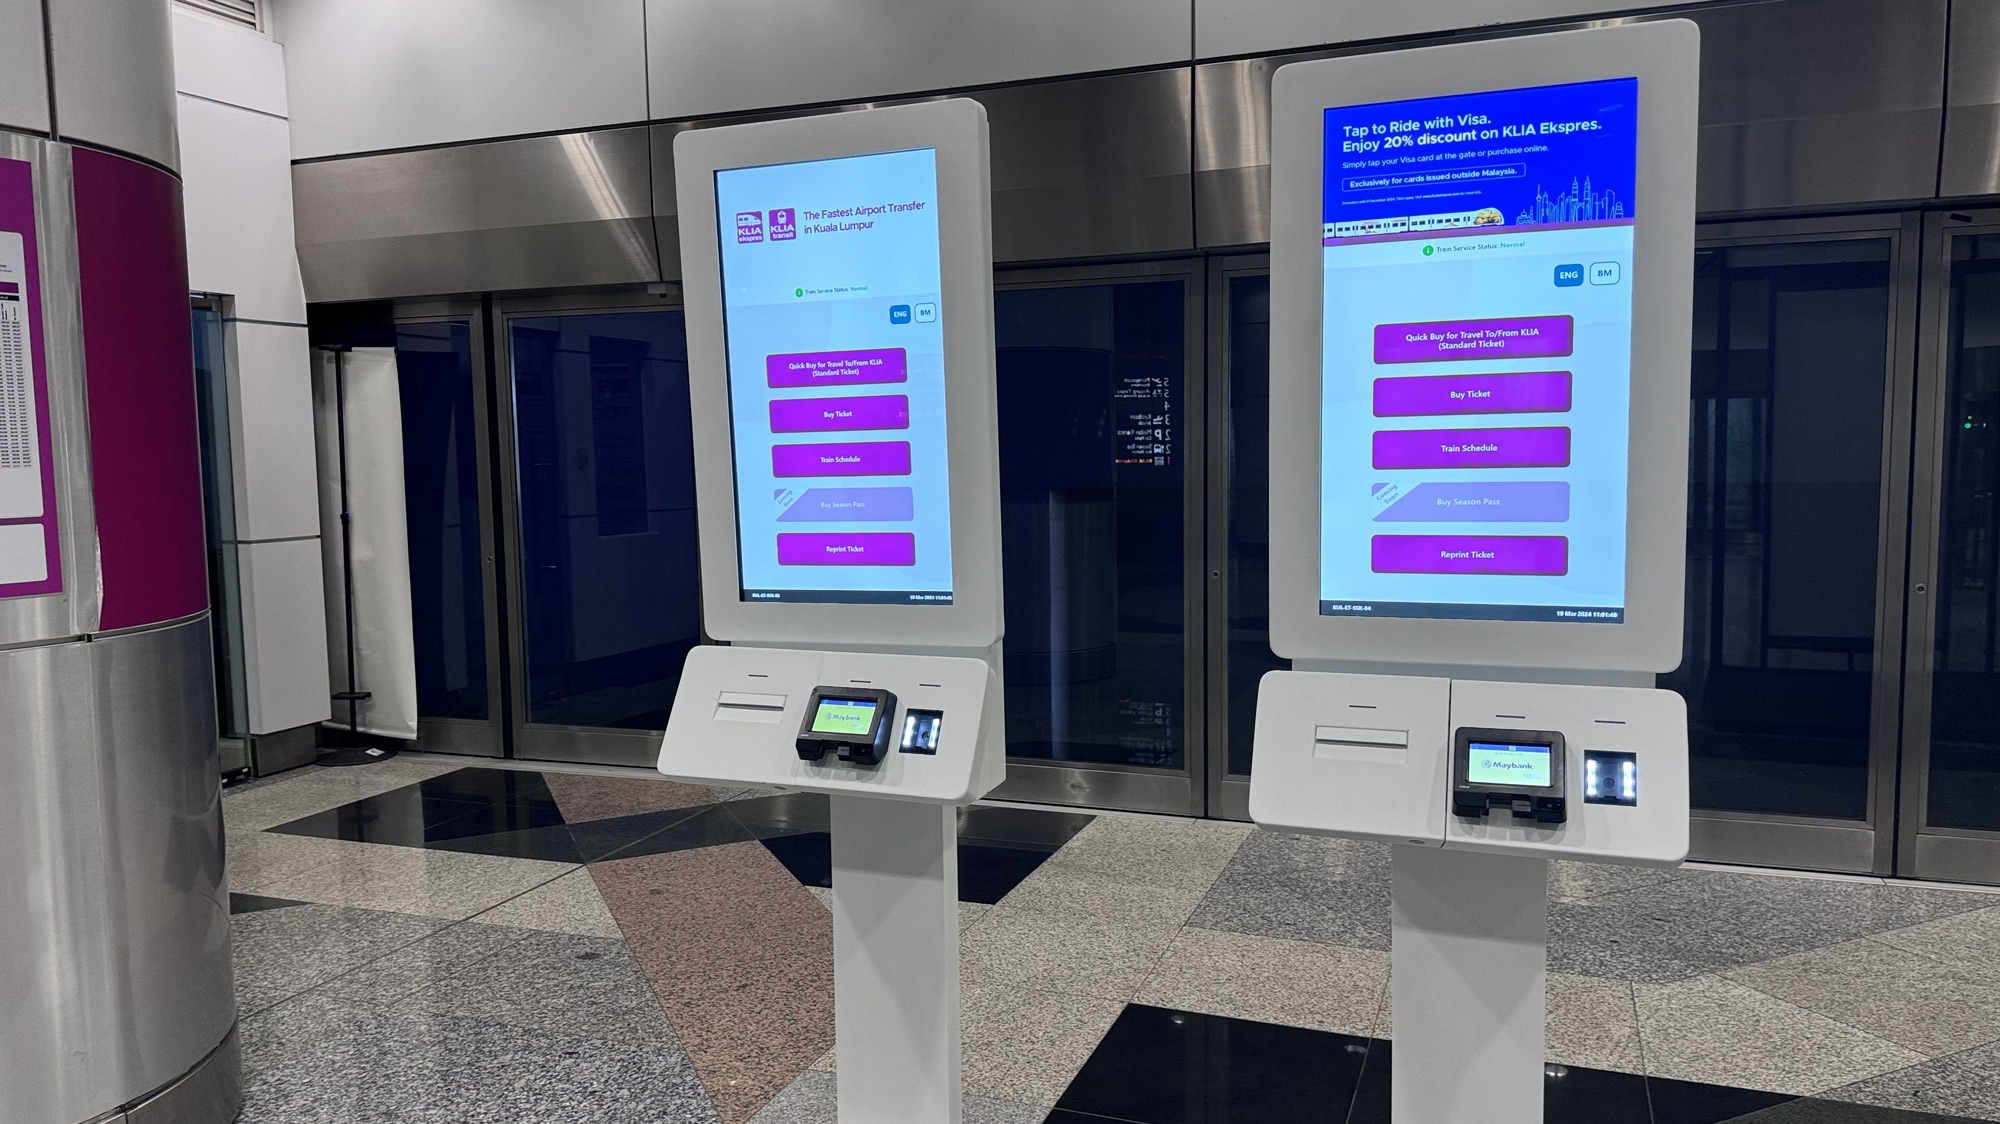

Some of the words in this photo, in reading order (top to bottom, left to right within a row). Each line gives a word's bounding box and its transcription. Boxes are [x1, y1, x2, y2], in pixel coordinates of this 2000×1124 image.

[1343, 125, 1368, 138] Tap
[1372, 123, 1387, 134] to
[1390, 120, 1420, 133] Ride
[1424, 116, 1454, 129] with
[1457, 114, 1491, 126] Visa.
[1343, 139, 1380, 153] Enjoy
[1384, 135, 1414, 148] 20%
[1417, 130, 1477, 145] discount
[1481, 129, 1498, 140] on
[1503, 124, 1536, 138] KLIA
[1540, 120, 1602, 134] Ekspres.
[1342, 161, 1366, 169] Simply
[1382, 158, 1399, 166] your
[1417, 154, 1434, 162] card
[1459, 151, 1475, 159] gate
[1487, 147, 1522, 157] purchase
[1524, 145, 1549, 153] online.
[1350, 178, 1390, 188] Exclusively
[1392, 176, 1402, 184] for
[1404, 174, 1424, 183] cards
[1426, 173, 1450, 181] issued
[1452, 170, 1480, 179] outside
[1482, 167, 1517, 177] Malaysia.
[803, 211, 820, 220] The
[821, 207, 853, 219] Fastest
[855, 204, 886, 216] Airport
[888, 201, 925, 212] Transfer
[738, 227, 762, 236] KLIA
[770, 224, 795, 233] KLIA
[804, 225, 812, 234] in
[814, 223, 838, 233] Kuala
[839, 221, 874, 231] Lumpur
[1559, 271, 1579, 279] ENG
[1597, 269, 1612, 277] BM
[1406, 333, 1428, 342] Quick
[1429, 333, 1444, 341] Buy
[1446, 332, 1458, 340] for
[1460, 330, 1483, 339] Travel
[1485, 329, 1519, 338] To/From
[1520, 328, 1539, 336] KLIA
[1438, 341, 1476, 351] (Standard
[1478, 340, 1505, 349] Ticket)
[789, 362, 805, 370] Quick
[806, 362, 816, 370] Buy
[827, 360, 844, 368] Travel
[845, 359, 869, 367] To/From
[812, 369, 839, 378] (Standard
[1450, 391, 1465, 400] Buy
[1467, 390, 1491, 398] Ticket
[823, 411, 835, 419] Buy
[1441, 445, 1460, 453] Train
[1462, 444, 1498, 452] Schedule
[1376, 483, 1398, 501] Coming
[1384, 491, 1399, 505] Soon
[1437, 498, 1452, 507] Buy
[1454, 498, 1481, 506] Season
[1483, 498, 1500, 506] Pass
[820, 501, 831, 509] Buy
[826, 545, 846, 553] Reprint
[1440, 551, 1469, 560] Reprint
[1471, 551, 1495, 559] Ticket
[1492, 761, 1533, 770] Maybank
